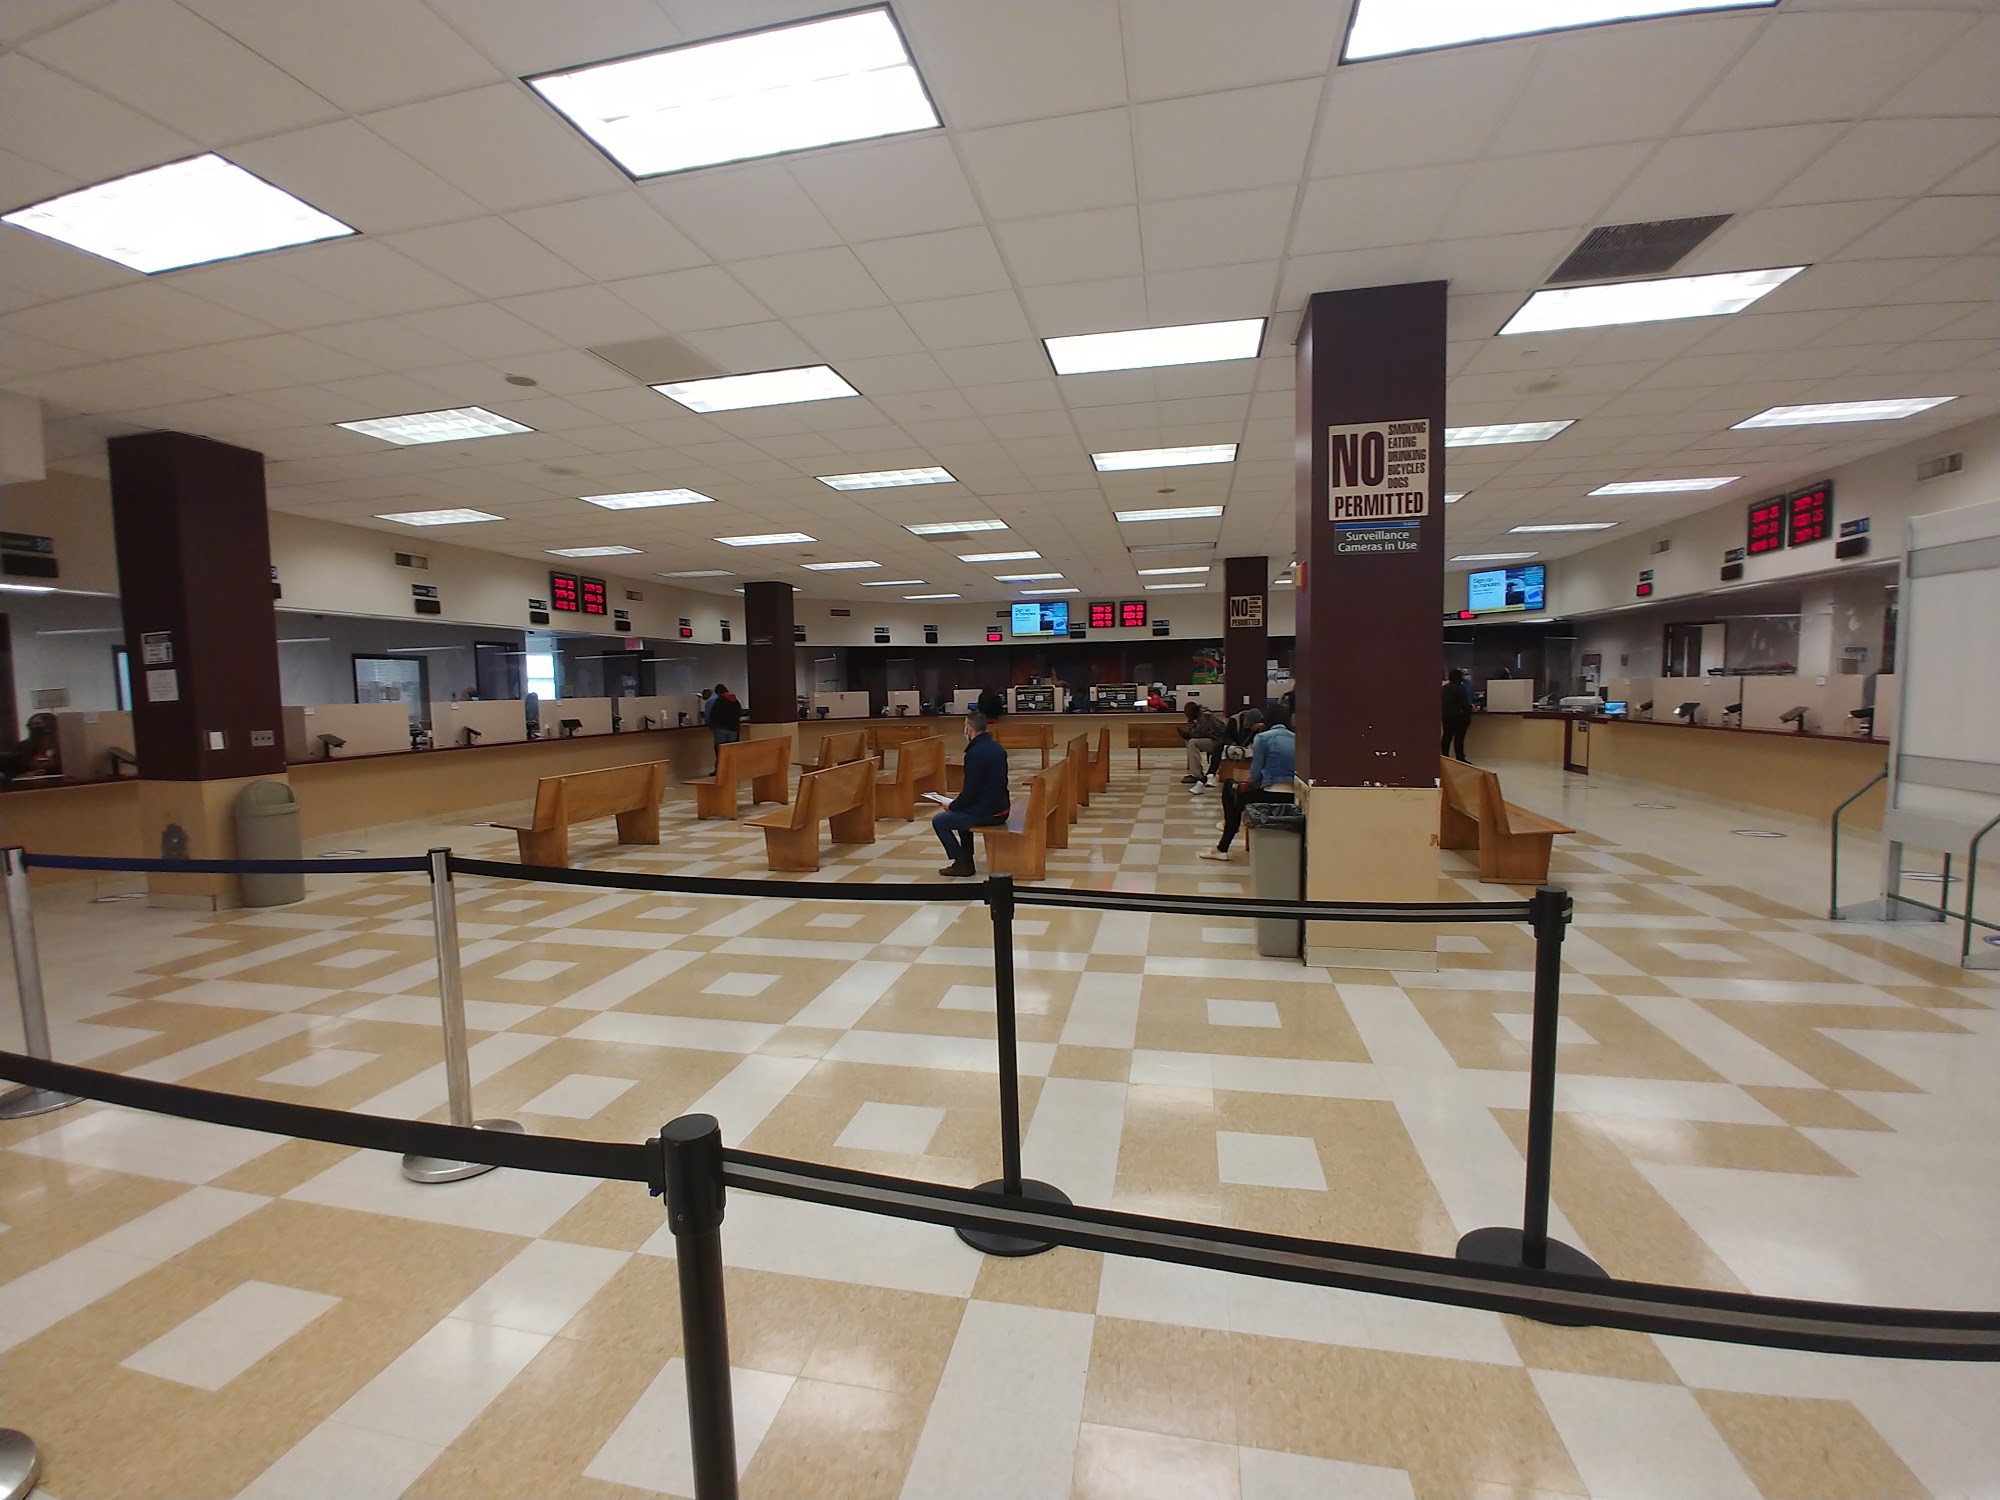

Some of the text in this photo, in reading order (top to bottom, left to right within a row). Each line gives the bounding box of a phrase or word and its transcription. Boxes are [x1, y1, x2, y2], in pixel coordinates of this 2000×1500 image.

[1388, 421, 1426, 435] SMOKING
[1388, 436, 1416, 448] EATING
[1332, 431, 1385, 488] NO
[1388, 449, 1426, 462] DRINKING
[1388, 462, 1425, 475] BICYCLES
[1388, 476, 1409, 488] DOGS
[1335, 491, 1423, 518] PERMITTED
[1345, 530, 1410, 541] Surveillance
[1337, 540, 1418, 552] Cameras in Use
[1231, 598, 1248, 617] NO
